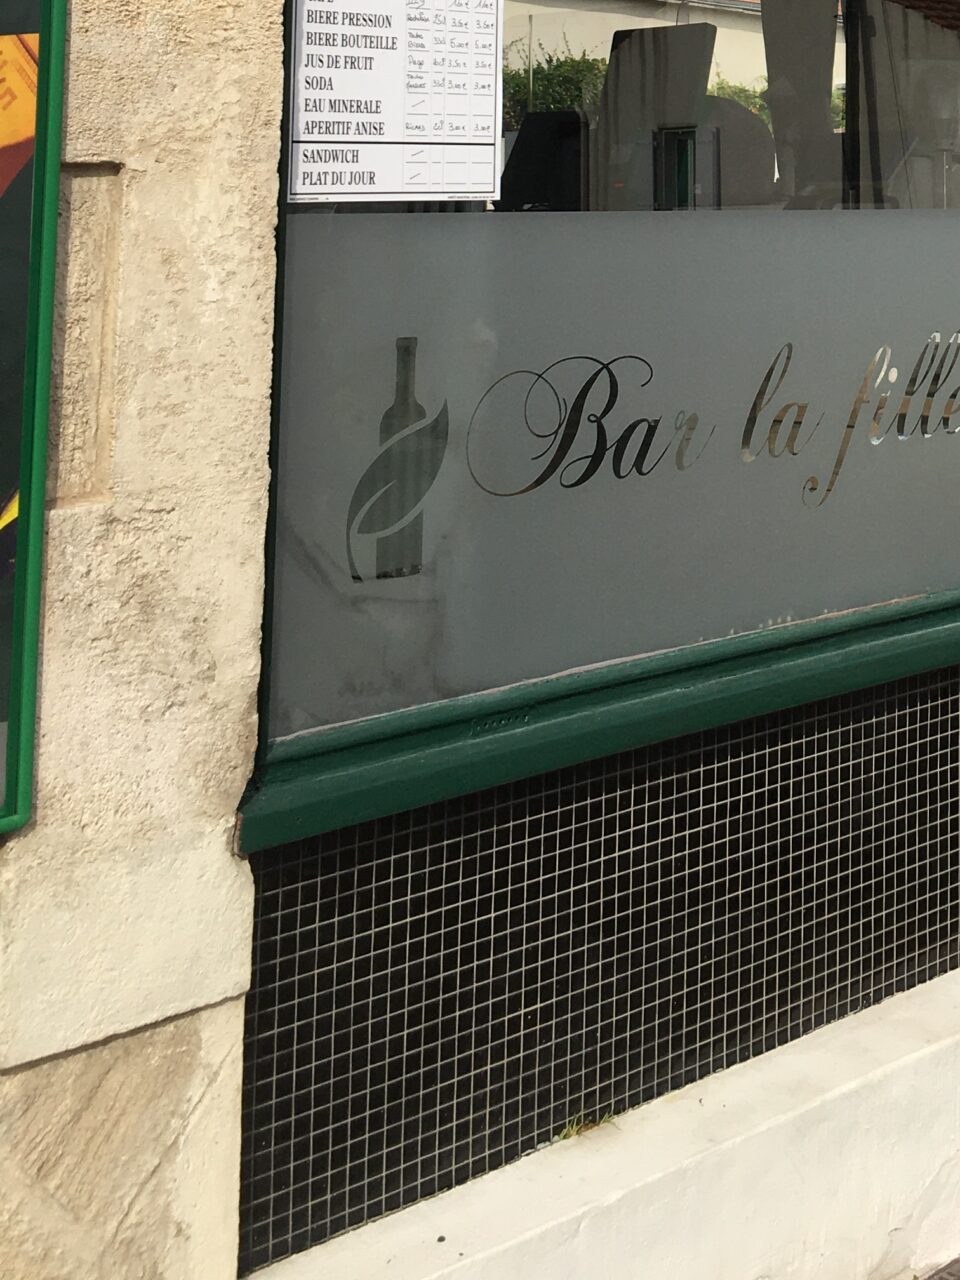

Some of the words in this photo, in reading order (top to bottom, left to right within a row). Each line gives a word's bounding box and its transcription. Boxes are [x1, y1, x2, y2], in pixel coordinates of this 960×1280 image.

[307, 9, 338, 25] BIERE
[342, 12, 392, 28] PRESSION
[306, 32, 338, 46] BIERE
[341, 34, 398, 50] BOUTEILLE
[304, 54, 324, 68] JUS
[327, 55, 341, 68] DE
[344, 56, 374, 70] FRUIT
[304, 75, 334, 91] SODA
[304, 98, 325, 112] EAU
[328, 99, 382, 113] MINERALE
[303, 120, 352, 135] APERITIF
[354, 122, 385, 135] ANISE
[303, 149, 359, 163] SANDWICH
[302, 171, 329, 185] PLAT
[331, 171, 346, 185] DU
[348, 171, 376, 185] JOUR
[466, 355, 716, 497] Bar
[740, 342, 826, 463] la
